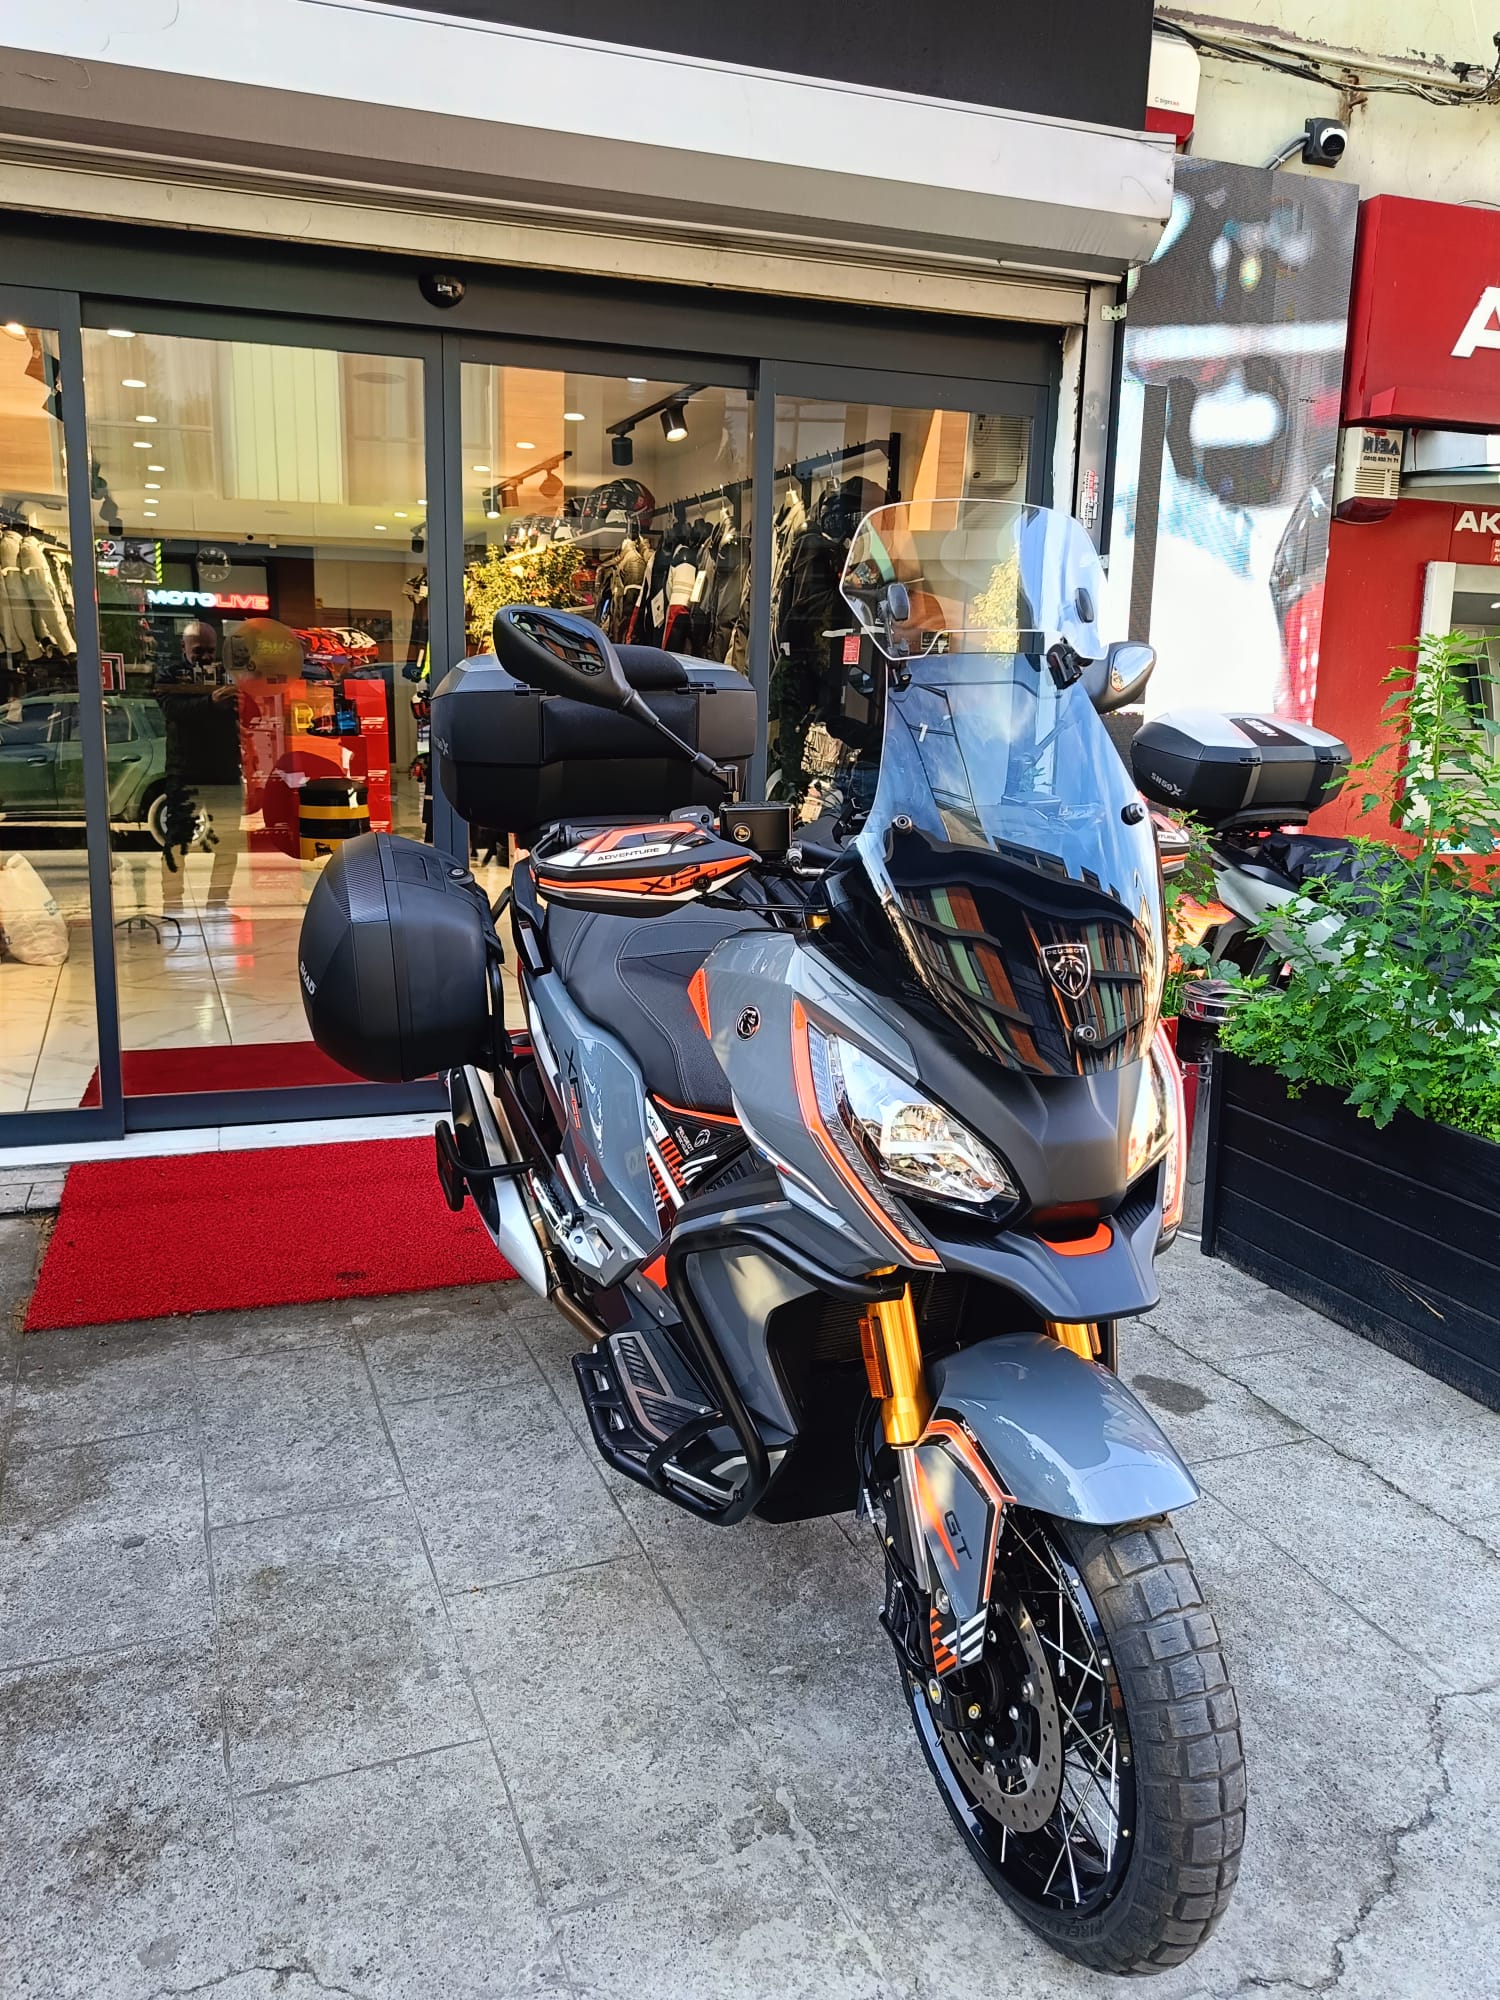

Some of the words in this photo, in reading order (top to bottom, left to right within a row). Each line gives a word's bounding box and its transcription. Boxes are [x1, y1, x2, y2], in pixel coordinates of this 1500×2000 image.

[146, 588, 270, 611] MOTOLIVE
[597, 847, 660, 861] ADVENTURE
[640, 866, 718, 896] XP40
[944, 1510, 973, 1559] GT
